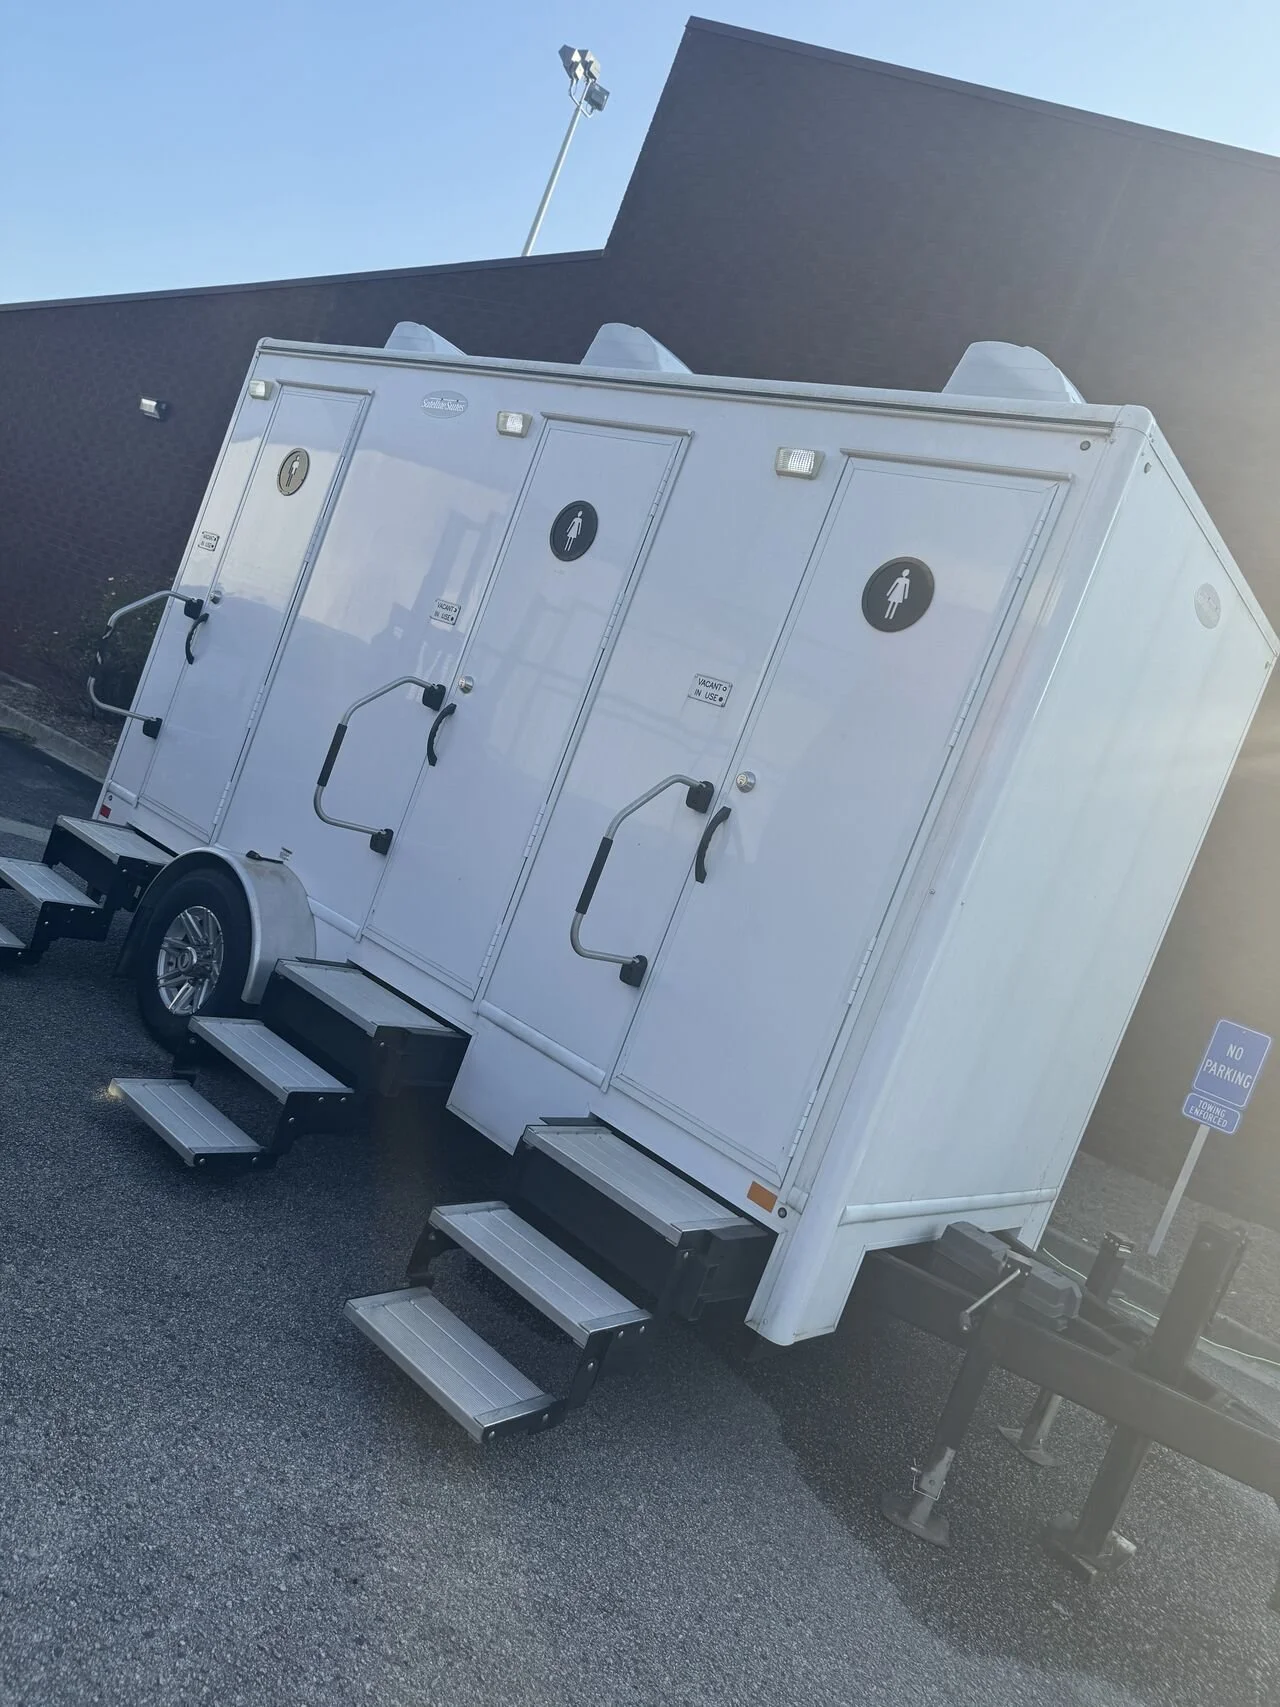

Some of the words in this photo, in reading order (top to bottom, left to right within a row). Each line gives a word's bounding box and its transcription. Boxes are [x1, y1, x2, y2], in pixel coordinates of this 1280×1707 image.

[437, 601, 454, 612] VACANT
[441, 613, 451, 621] USE
[698, 677, 723, 691] VACANT
[694, 689, 702, 697] IN
[705, 691, 718, 702] USE
[1226, 1043, 1244, 1061] NO
[1203, 1058, 1253, 1089] PARKING
[1189, 1105, 1228, 1128] ENFORCED
[1198, 1099, 1226, 1118] TOWING
